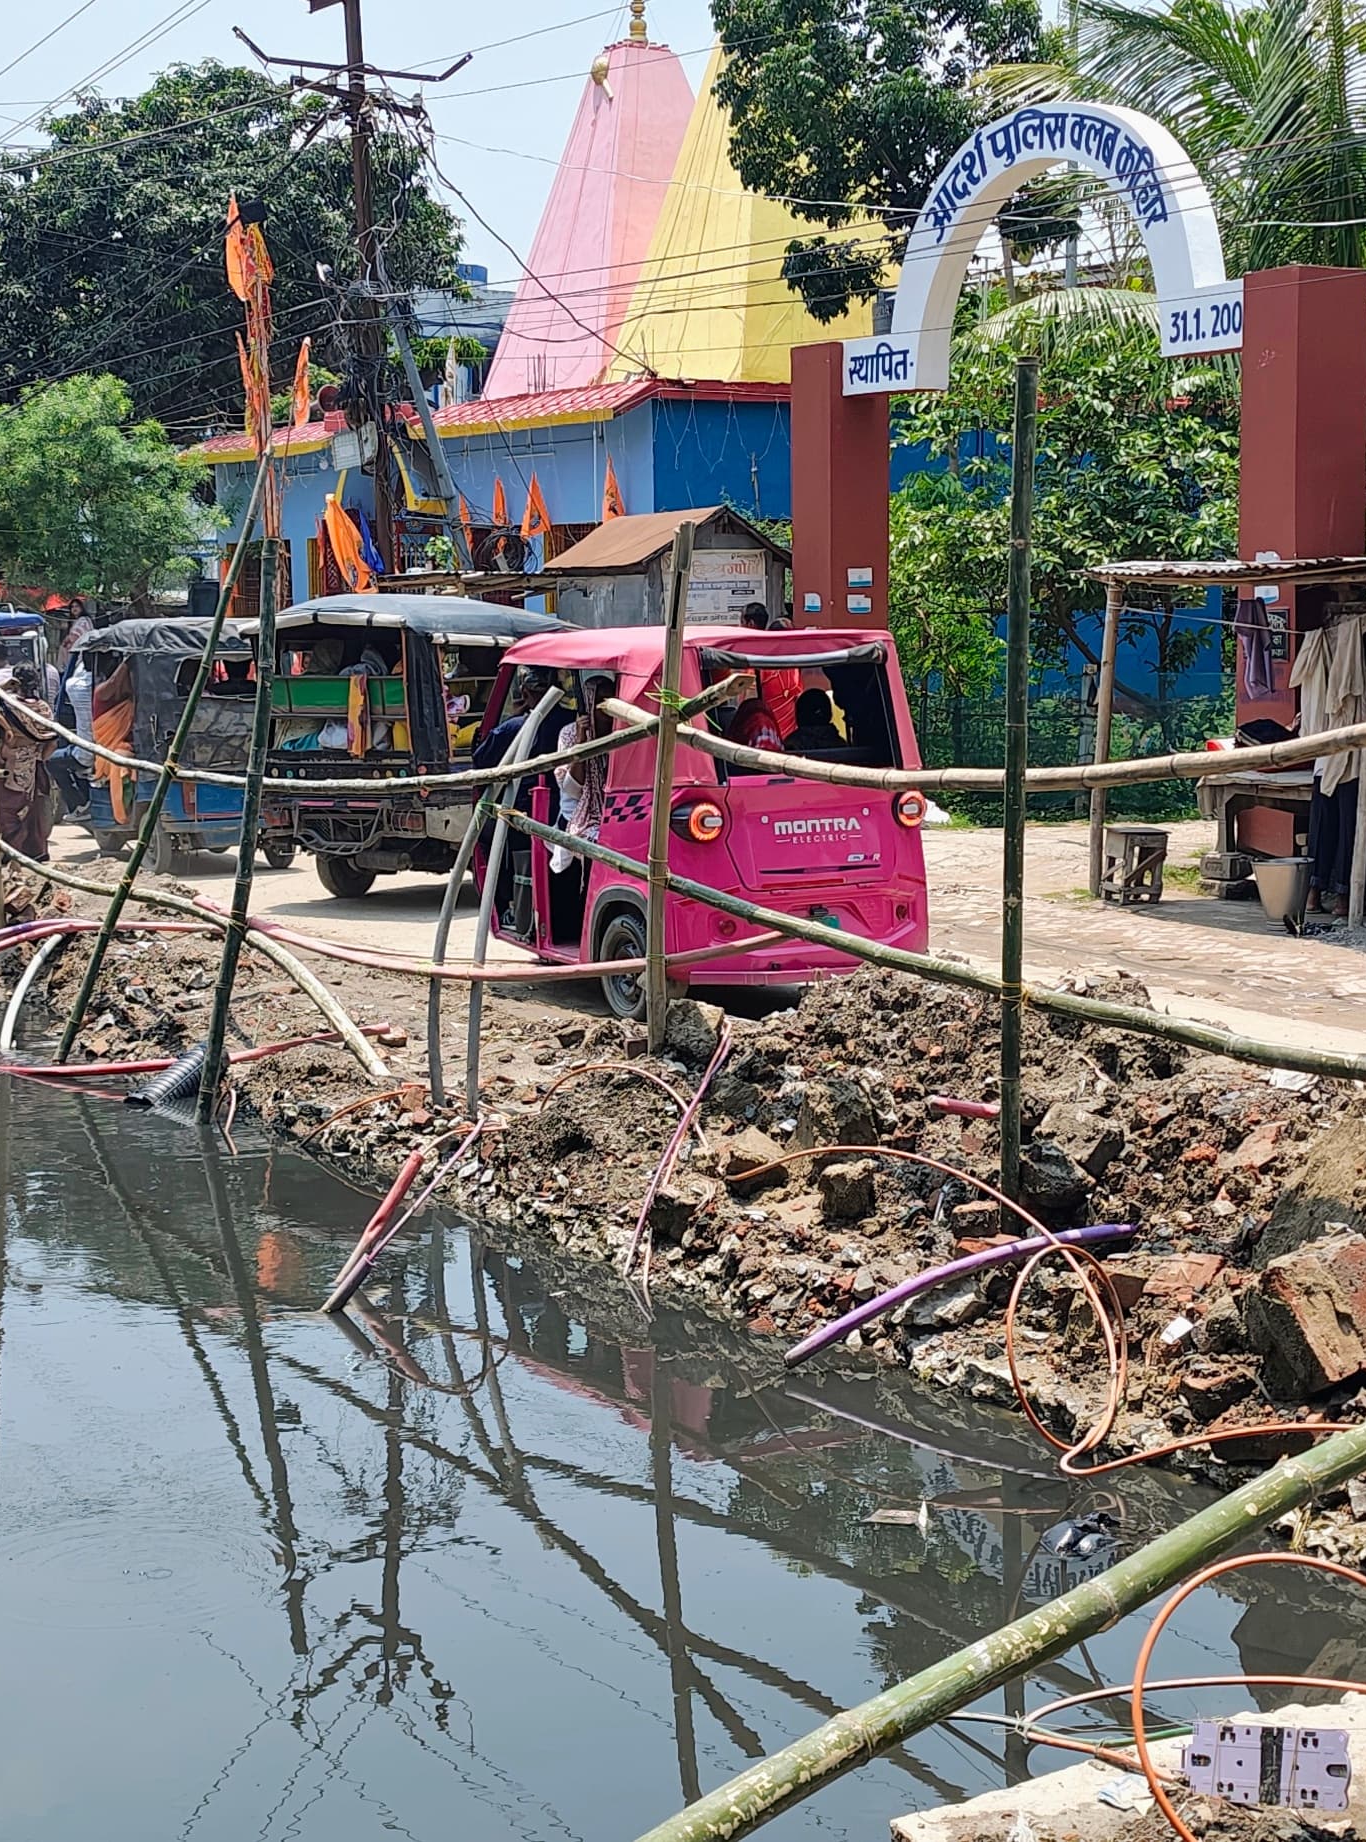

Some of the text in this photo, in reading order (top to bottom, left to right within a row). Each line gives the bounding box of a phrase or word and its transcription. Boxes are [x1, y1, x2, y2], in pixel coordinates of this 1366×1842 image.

[924, 108, 1169, 244] आदर्श पुलिस क्लब कटिहार
[774, 817, 861, 835] MONTRA
[792, 833, 847, 844] ELECTRIC
